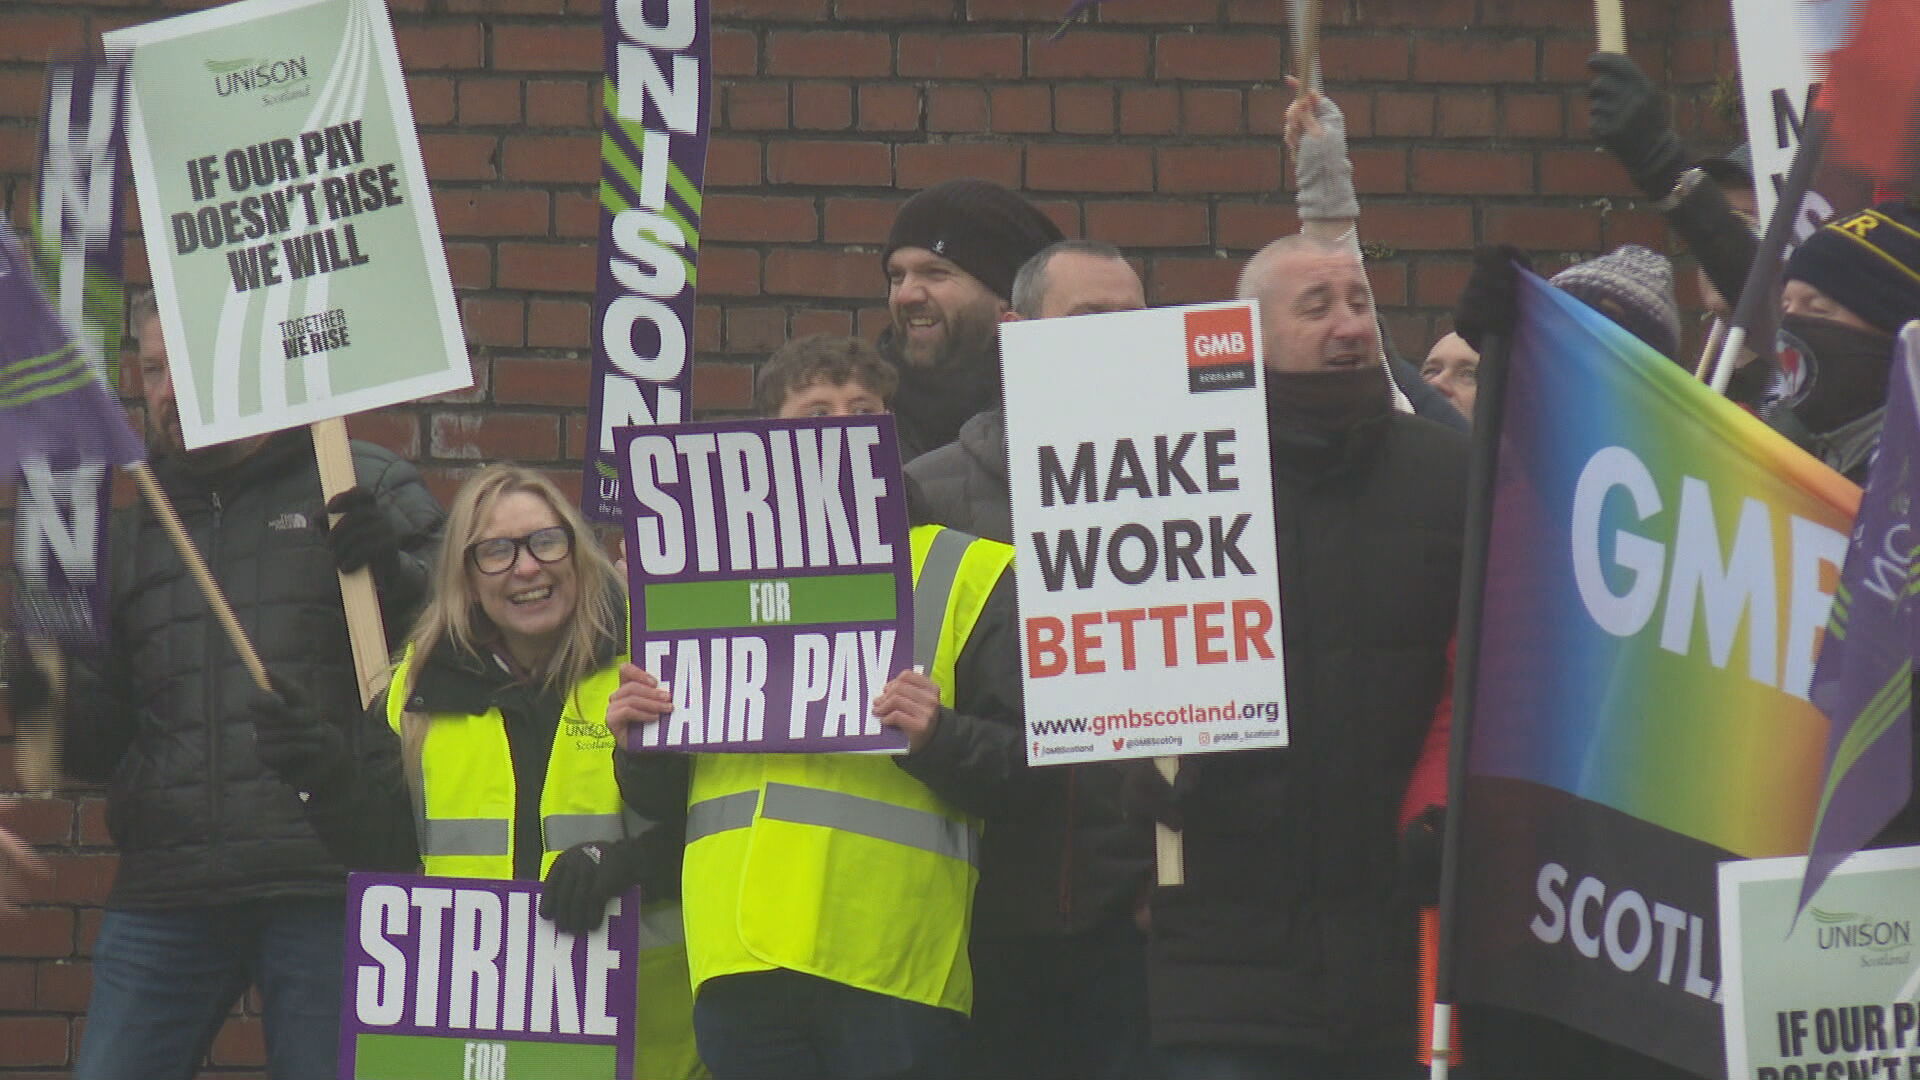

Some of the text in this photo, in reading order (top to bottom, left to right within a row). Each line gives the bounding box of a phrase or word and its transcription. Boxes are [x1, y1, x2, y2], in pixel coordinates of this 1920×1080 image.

[215, 56, 307, 97] UNISON
[187, 119, 365, 202] IF OUR PAY
[171, 163, 404, 256] DOESN'T RISE
[227, 223, 370, 293] WE WILL
[278, 309, 346, 338] TOGETHER
[282, 326, 351, 360] WE RISE
[1193, 331, 1247, 357] GMB
[1199, 370, 1246, 383] SCOTLAND
[1037, 428, 1240, 508] MAKE
[629, 426, 894, 576] STRIKE
[1031, 513, 1257, 592] WORK
[750, 581, 791, 624] FOR
[1025, 598, 1276, 679] BETTER
[642, 630, 897, 747] FAIR PAY
[1031, 700, 1279, 736] www.gmbscotland.org
[356, 885, 622, 1036] STRIKE
[1530, 862, 1723, 1004] SCOTL
[1818, 921, 1911, 950] UNISON
[464, 1042, 506, 1080] FOR
[1777, 1010, 1809, 1058] IF
[1815, 1004, 1888, 1055] OUR
